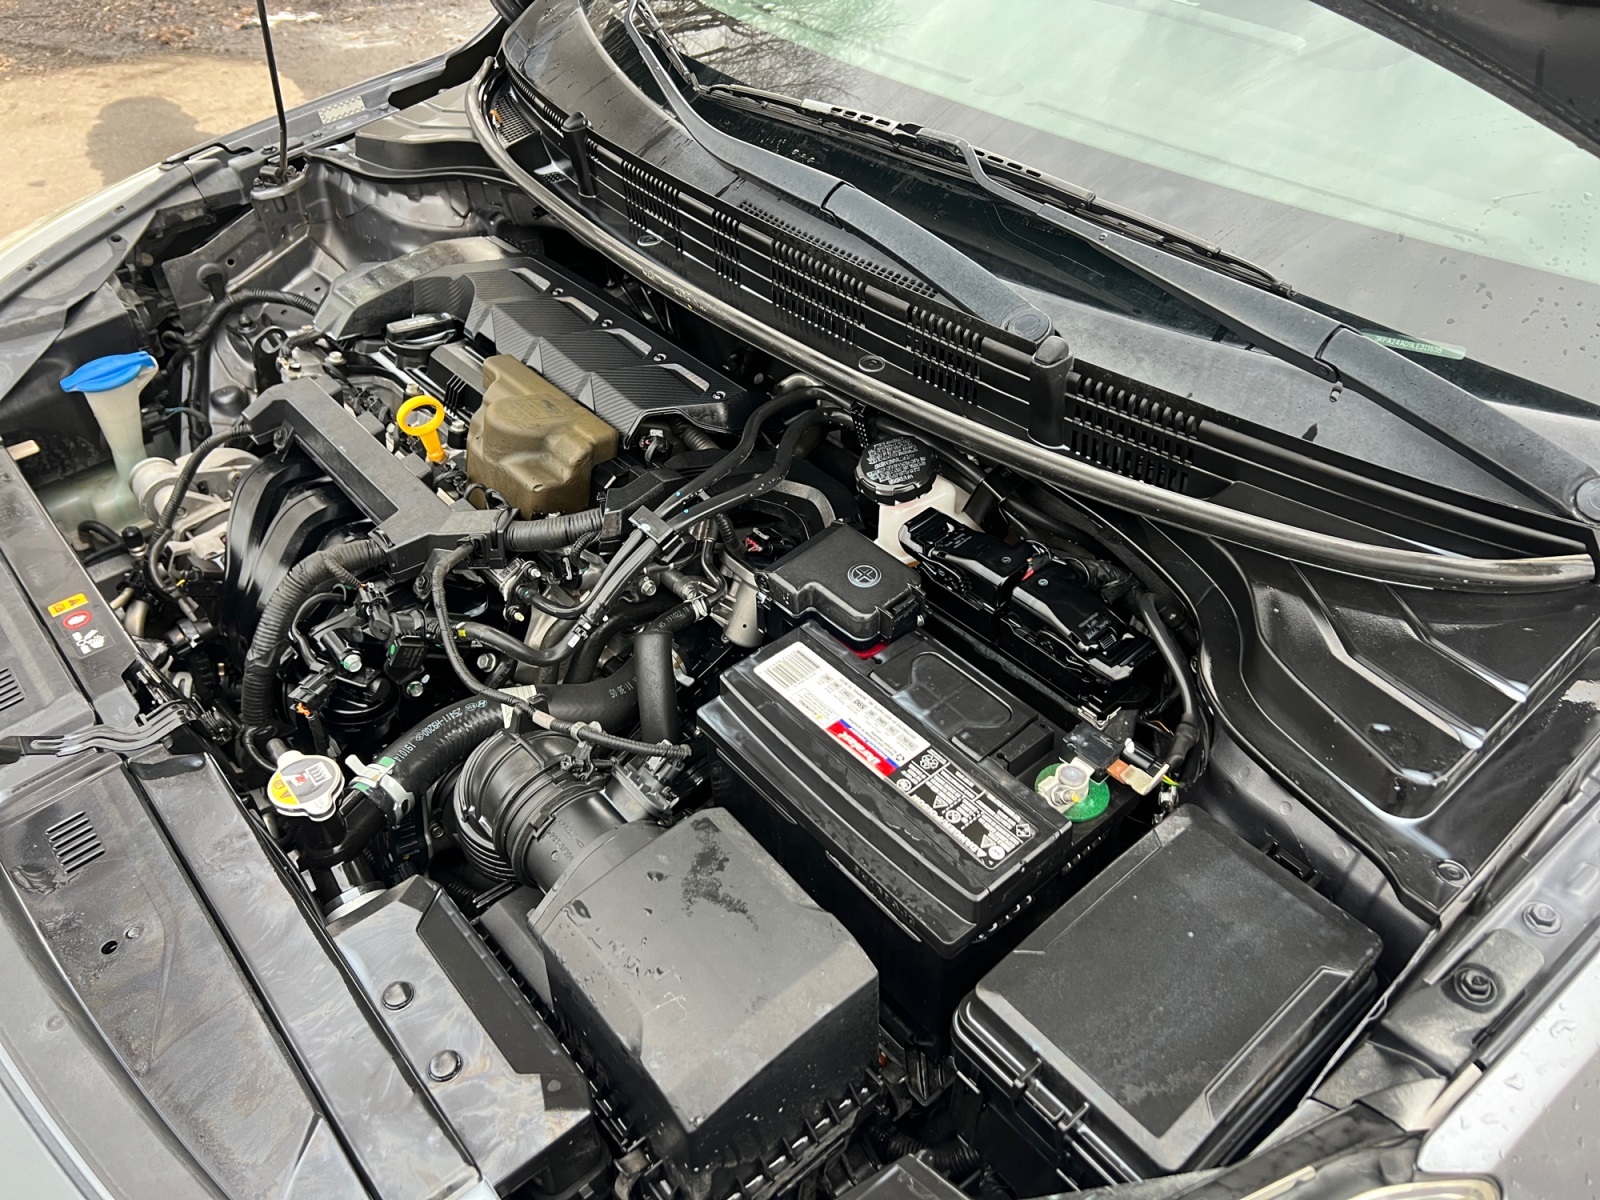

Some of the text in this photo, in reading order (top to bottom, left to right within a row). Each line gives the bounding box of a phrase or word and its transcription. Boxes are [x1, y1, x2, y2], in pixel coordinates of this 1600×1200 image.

[852, 698, 867, 710] 590
[421, 707, 463, 738] 25411-H9200
[835, 729, 882, 767] Duralast
